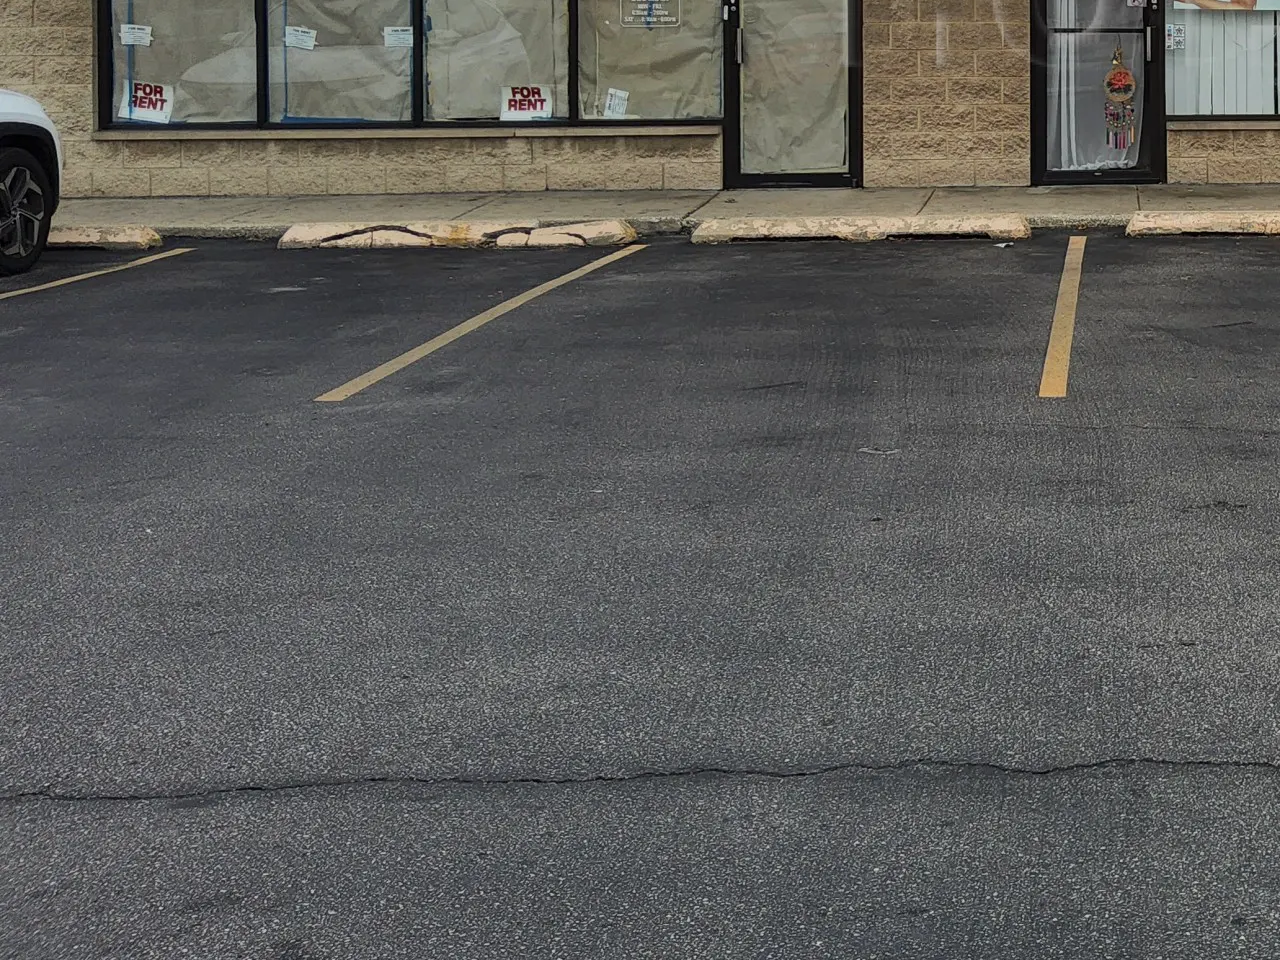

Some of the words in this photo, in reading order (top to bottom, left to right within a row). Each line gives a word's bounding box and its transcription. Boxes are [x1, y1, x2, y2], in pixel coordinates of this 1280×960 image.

[133, 82, 164, 97] FOR
[511, 87, 541, 98] FOR
[131, 95, 167, 111] RENT
[508, 99, 546, 111] RENT
